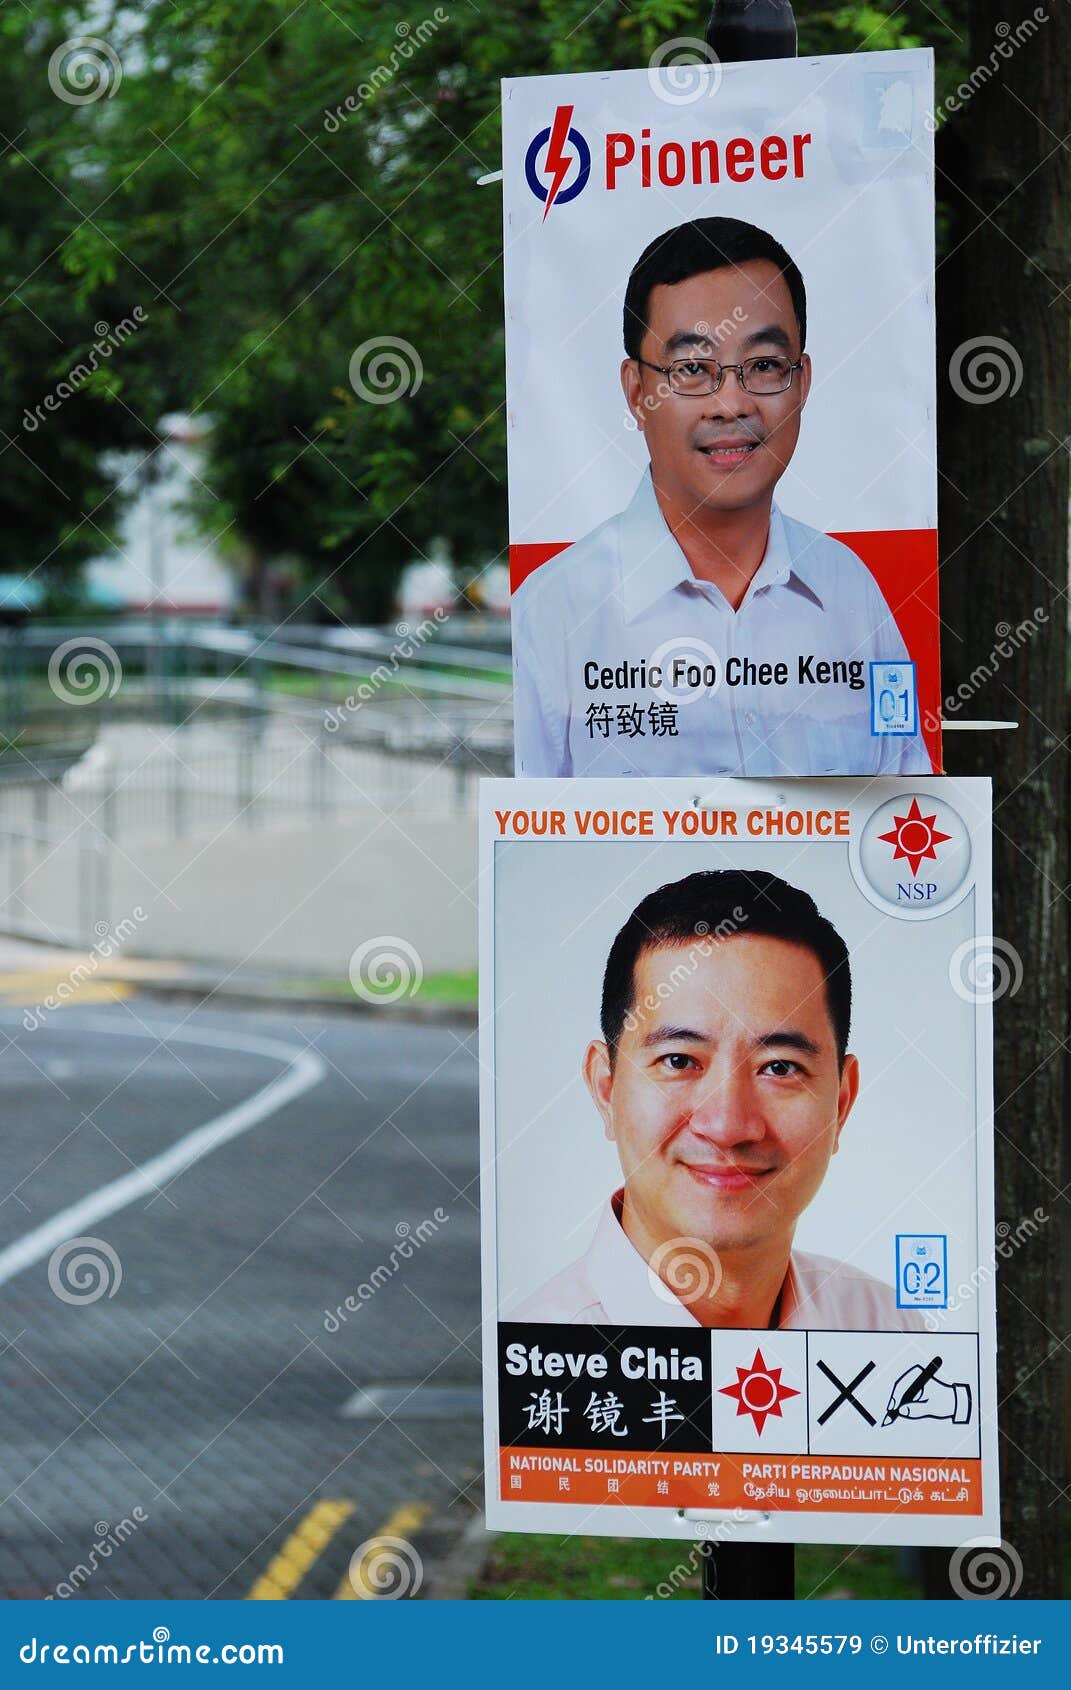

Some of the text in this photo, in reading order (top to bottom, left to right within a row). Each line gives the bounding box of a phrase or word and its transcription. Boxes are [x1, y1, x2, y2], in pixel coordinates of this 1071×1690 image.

[606, 128, 812, 190] Pioneer
[583, 655, 866, 690] Cedric Foo Chee Keng
[585, 701, 680, 738] 符致镜
[879, 689, 909, 722] 01
[494, 810, 851, 835] YOUR VOICE YOUR CHOICE
[896, 882, 938, 900] NSP
[903, 1262, 941, 1294] 02
[505, 1343, 703, 1381] Steve Chia
[521, 1388, 686, 1440] 谢镜丰
[510, 1455, 721, 1477] NATIONAL SOLIDARITY PARTY
[742, 1463, 971, 1484] PARTI PERPADUAN NASIONAL
